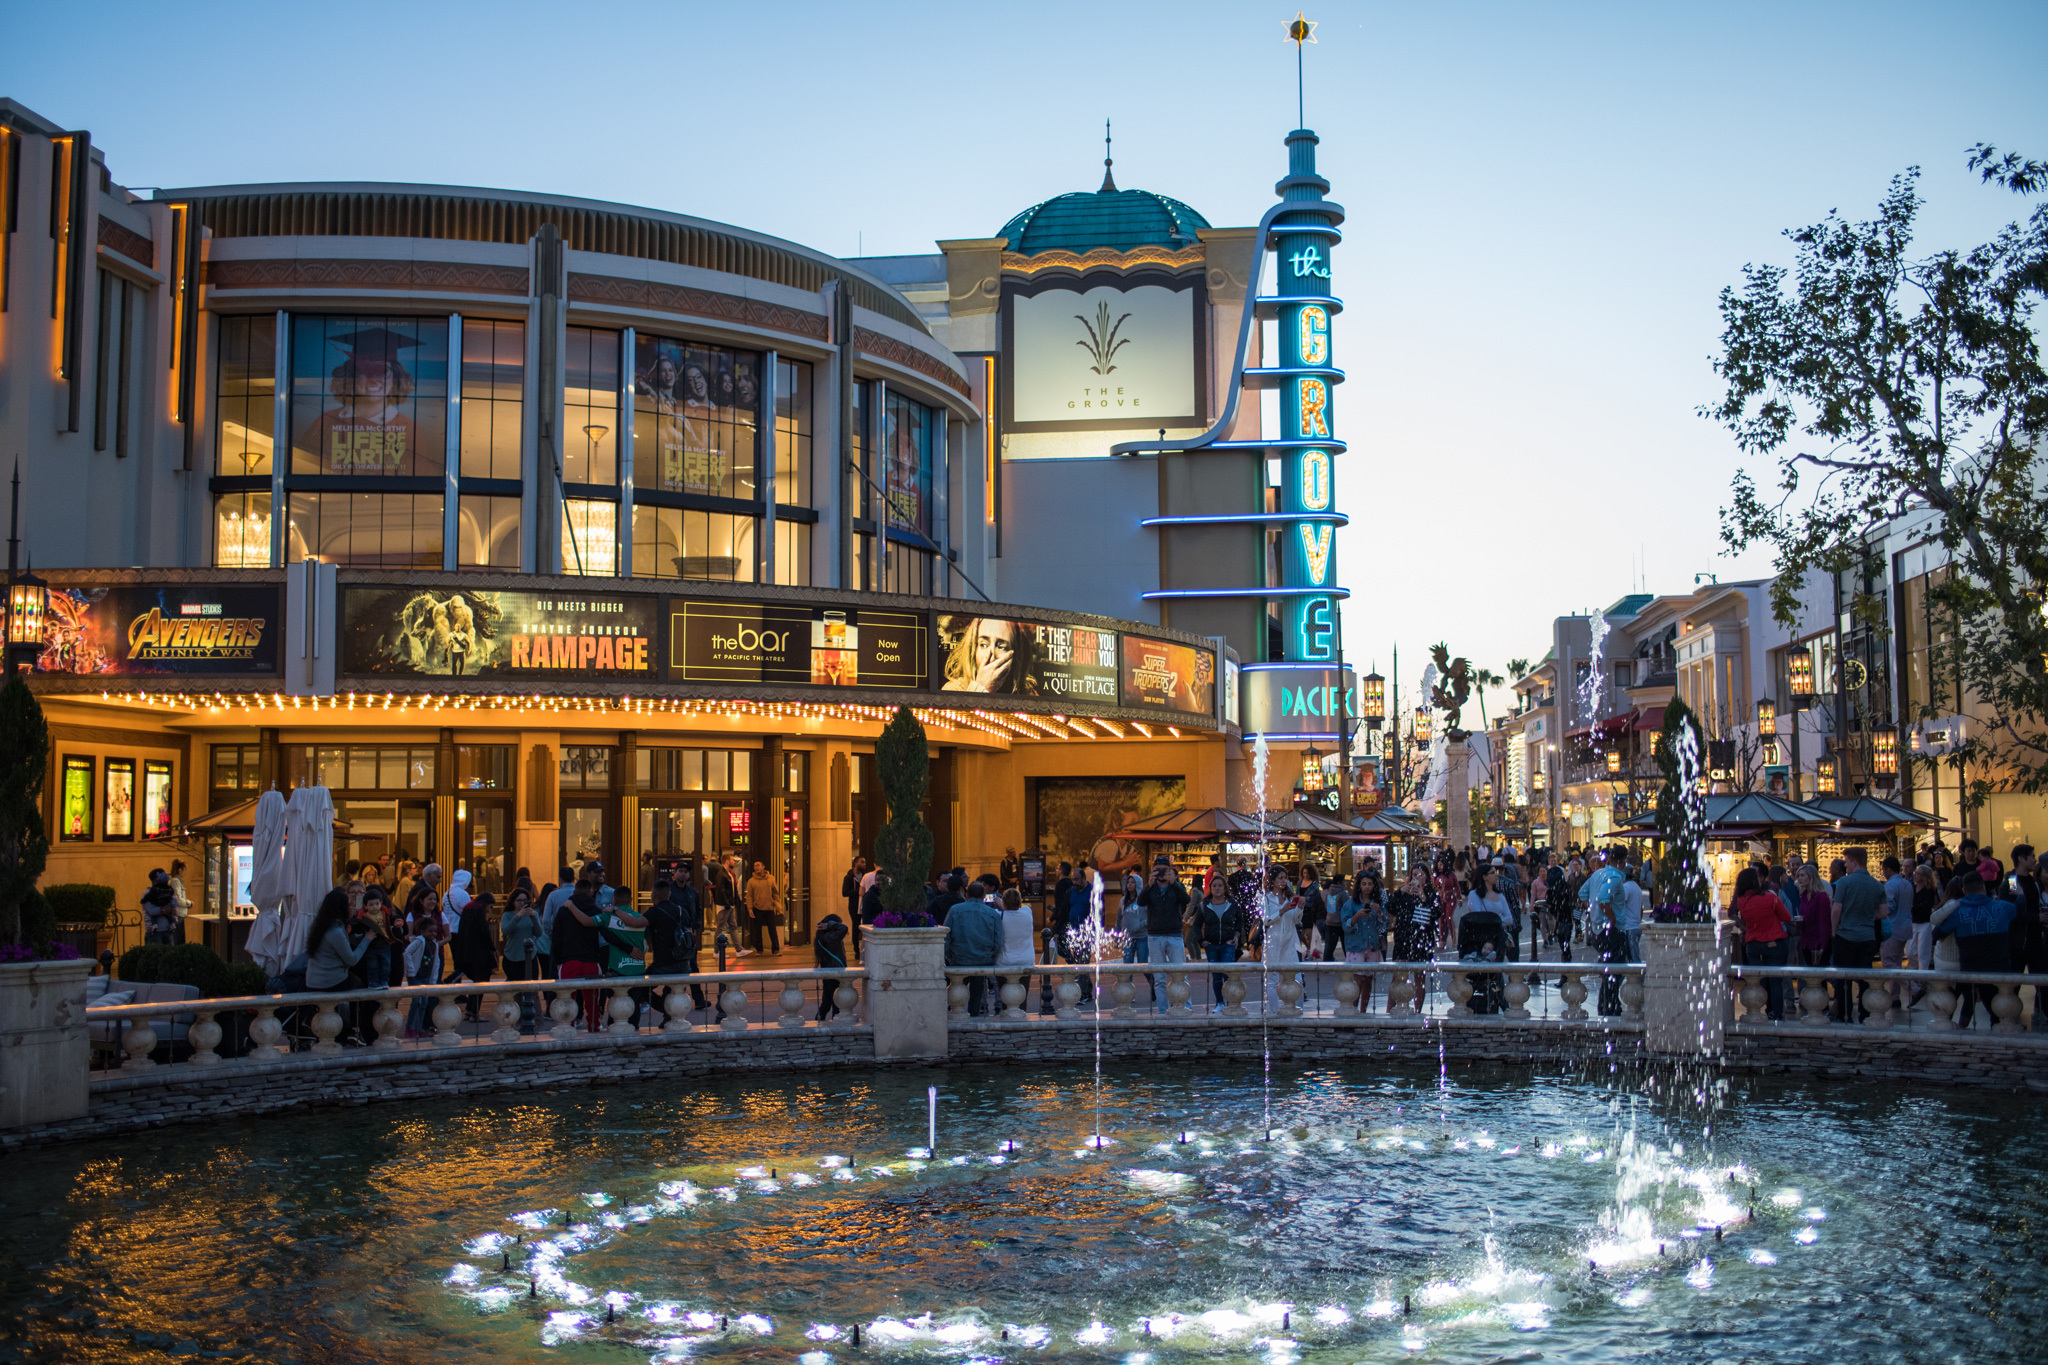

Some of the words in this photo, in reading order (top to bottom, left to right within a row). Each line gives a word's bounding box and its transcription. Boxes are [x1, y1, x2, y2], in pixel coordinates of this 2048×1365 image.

[1288, 246, 1332, 278] the
[1084, 387, 1124, 396] THE
[1067, 398, 1140, 409] GROVE
[331, 431, 384, 450] LIFE
[385, 432, 406, 443] OF
[664, 443, 692, 452] MELISA
[331, 449, 406, 465] PARTY
[664, 449, 709, 472] LIFE
[709, 455, 726, 466] OF
[664, 466, 726, 487] PARTY
[1298, 305, 1333, 658] GROVE
[684, 482, 708, 490] THEATER
[181, 604, 201, 614] MARVEL
[202, 604, 222, 615] STUDIOS
[537, 601, 552, 611] BIG
[557, 601, 586, 612] MEETS
[591, 602, 624, 613] BIGGER
[127, 607, 266, 660] AVENGERS
[522, 624, 572, 634] DWAYNE
[581, 625, 638, 636] JOHNSON
[1036, 625, 1046, 643] IF
[1047, 627, 1072, 646] THEY
[1073, 630, 1097, 649] HEAR
[1098, 633, 1115, 651] YOU
[143, 649, 213, 657] INFINITY
[511, 635, 648, 671] RAMPAGE
[878, 639, 899, 649] Now
[876, 652, 901, 663] Open
[1047, 643, 1072, 663] THEY
[1073, 647, 1097, 666] HUNT
[1098, 650, 1115, 668] YOU
[1141, 654, 1169, 673] SUPER
[1043, 681, 1049, 690] A
[1050, 677, 1084, 695] QUIET
[1086, 680, 1115, 695] PLACE
[1132, 668, 1171, 693] TROOPERS
[1167, 672, 1178, 698] 2
[1281, 686, 1354, 717] PACIFC
